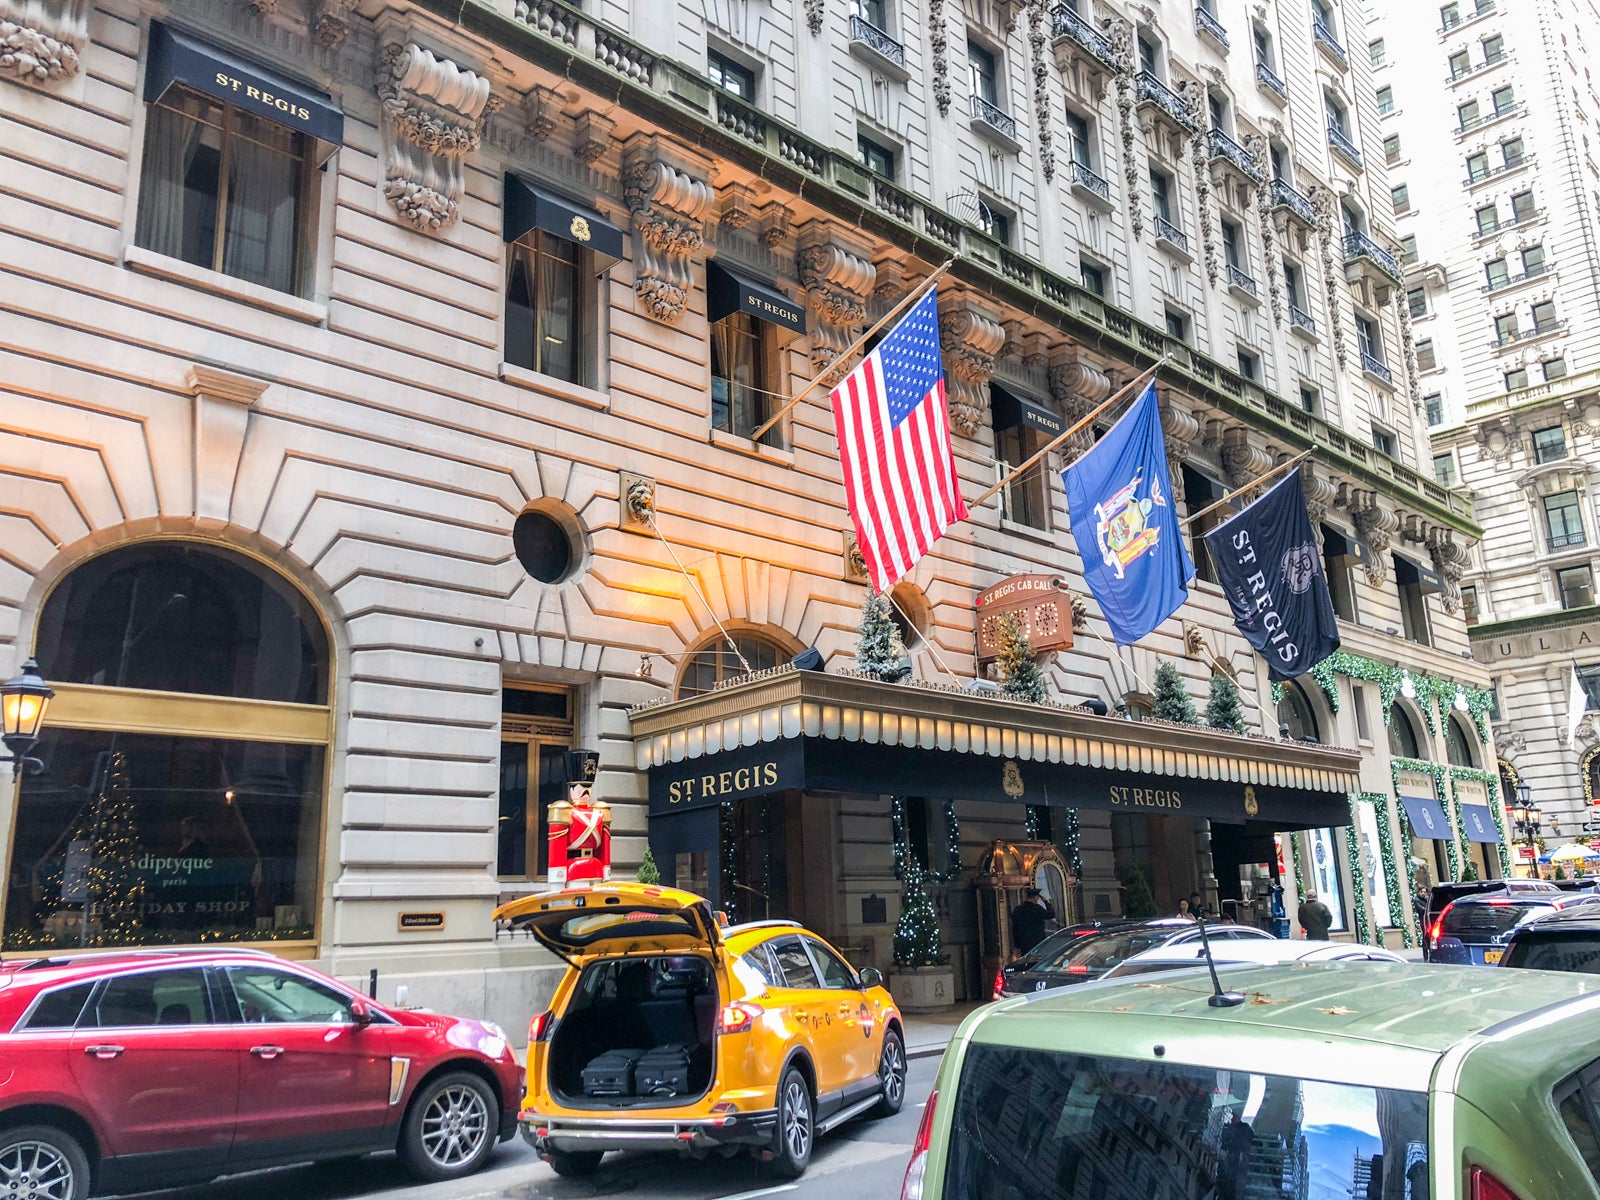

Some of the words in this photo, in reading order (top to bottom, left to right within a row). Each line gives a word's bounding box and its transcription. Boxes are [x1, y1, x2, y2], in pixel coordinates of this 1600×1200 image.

[246, 85, 310, 121] REGIS
[764, 303, 798, 323] REGIS
[1037, 416, 1060, 431] REGIS
[994, 582, 1015, 600] REGIS
[1017, 580, 1032, 591] CAB
[1034, 580, 1052, 591] CALL
[1246, 569, 1300, 663] REGIS
[701, 762, 778, 798] REGIS
[1132, 787, 1182, 809] REGIS
[137, 852, 214, 875] diptyque
[162, 877, 188, 888] paris
[195, 900, 250, 913] SHOP
